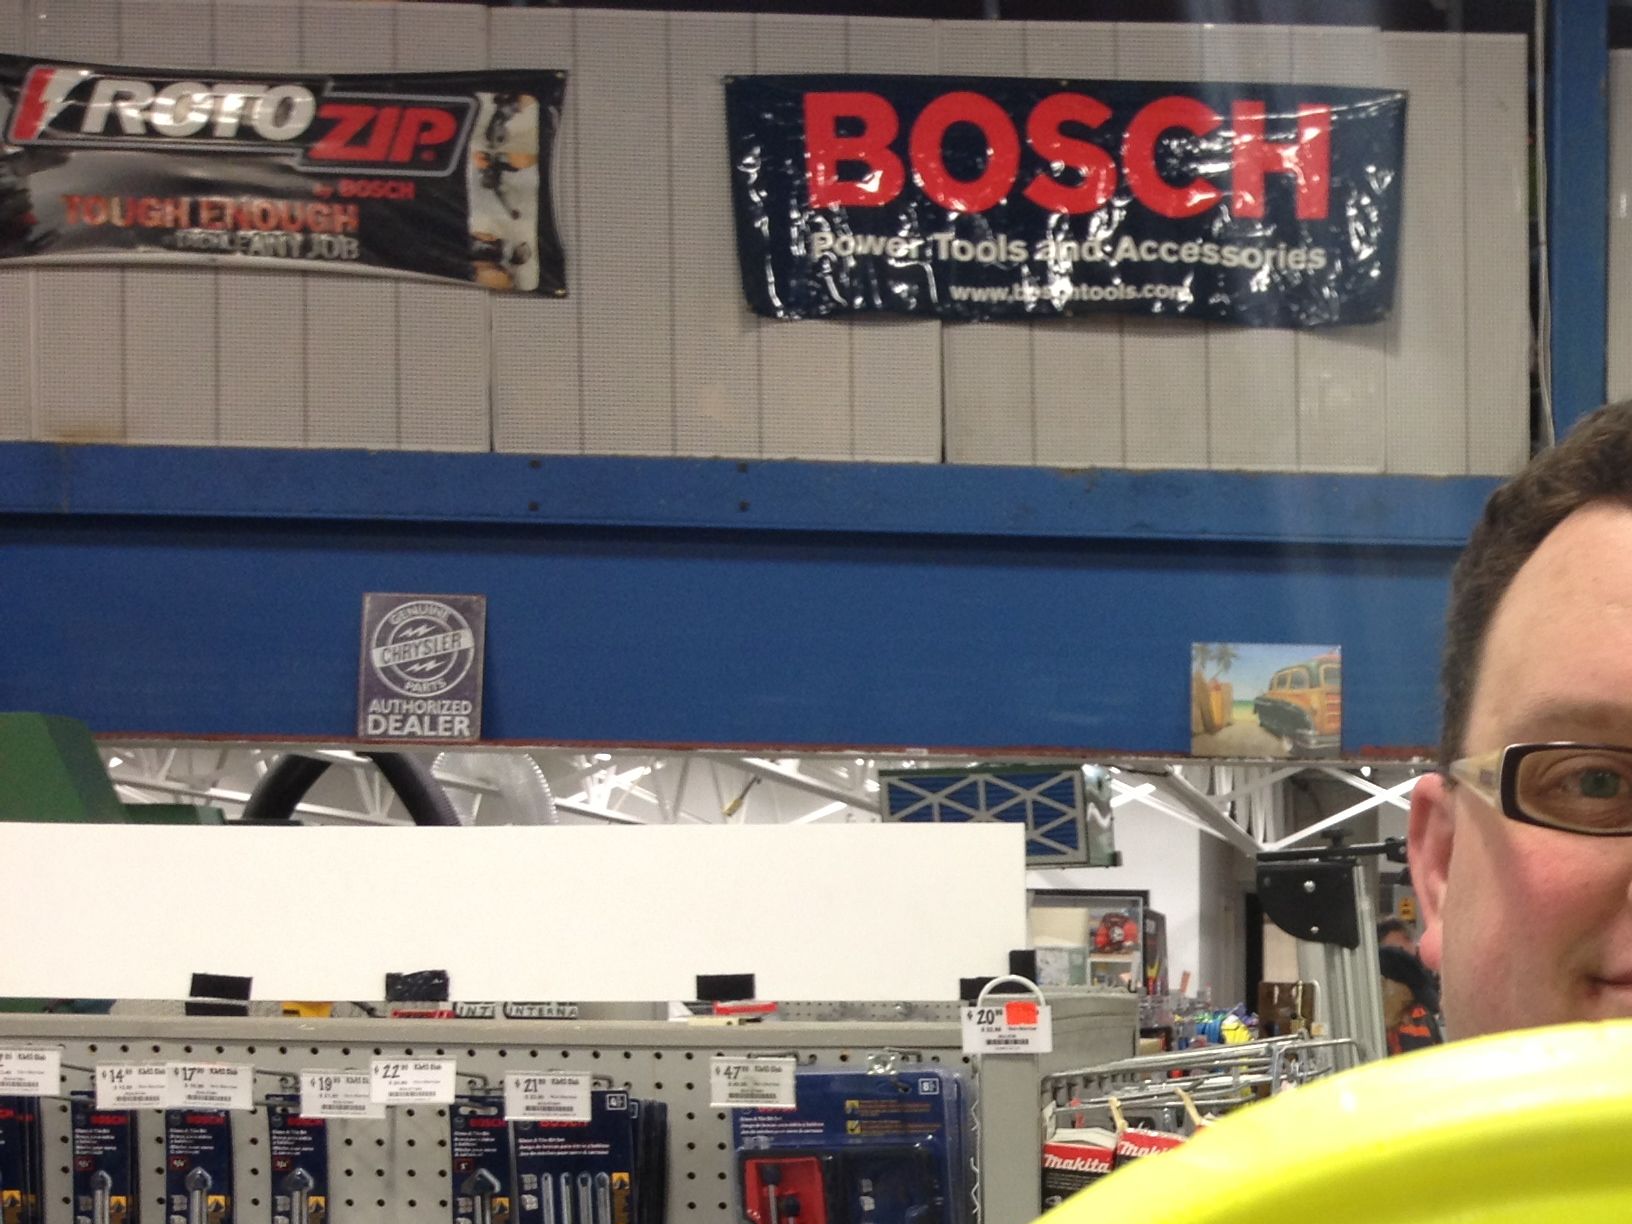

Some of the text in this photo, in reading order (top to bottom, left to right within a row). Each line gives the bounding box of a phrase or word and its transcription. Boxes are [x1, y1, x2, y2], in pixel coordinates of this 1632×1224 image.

[81, 79, 459, 162] ROTO ZIP
[803, 90, 1331, 219] BOSCH
[63, 194, 360, 232] TOUGH ENOUGH
[812, 232, 1326, 270] Power Tools and Accessories
[381, 631, 463, 664] CHRYSLER
[369, 698, 473, 715] AUTHORIZED
[367, 715, 471, 737] DEALER
